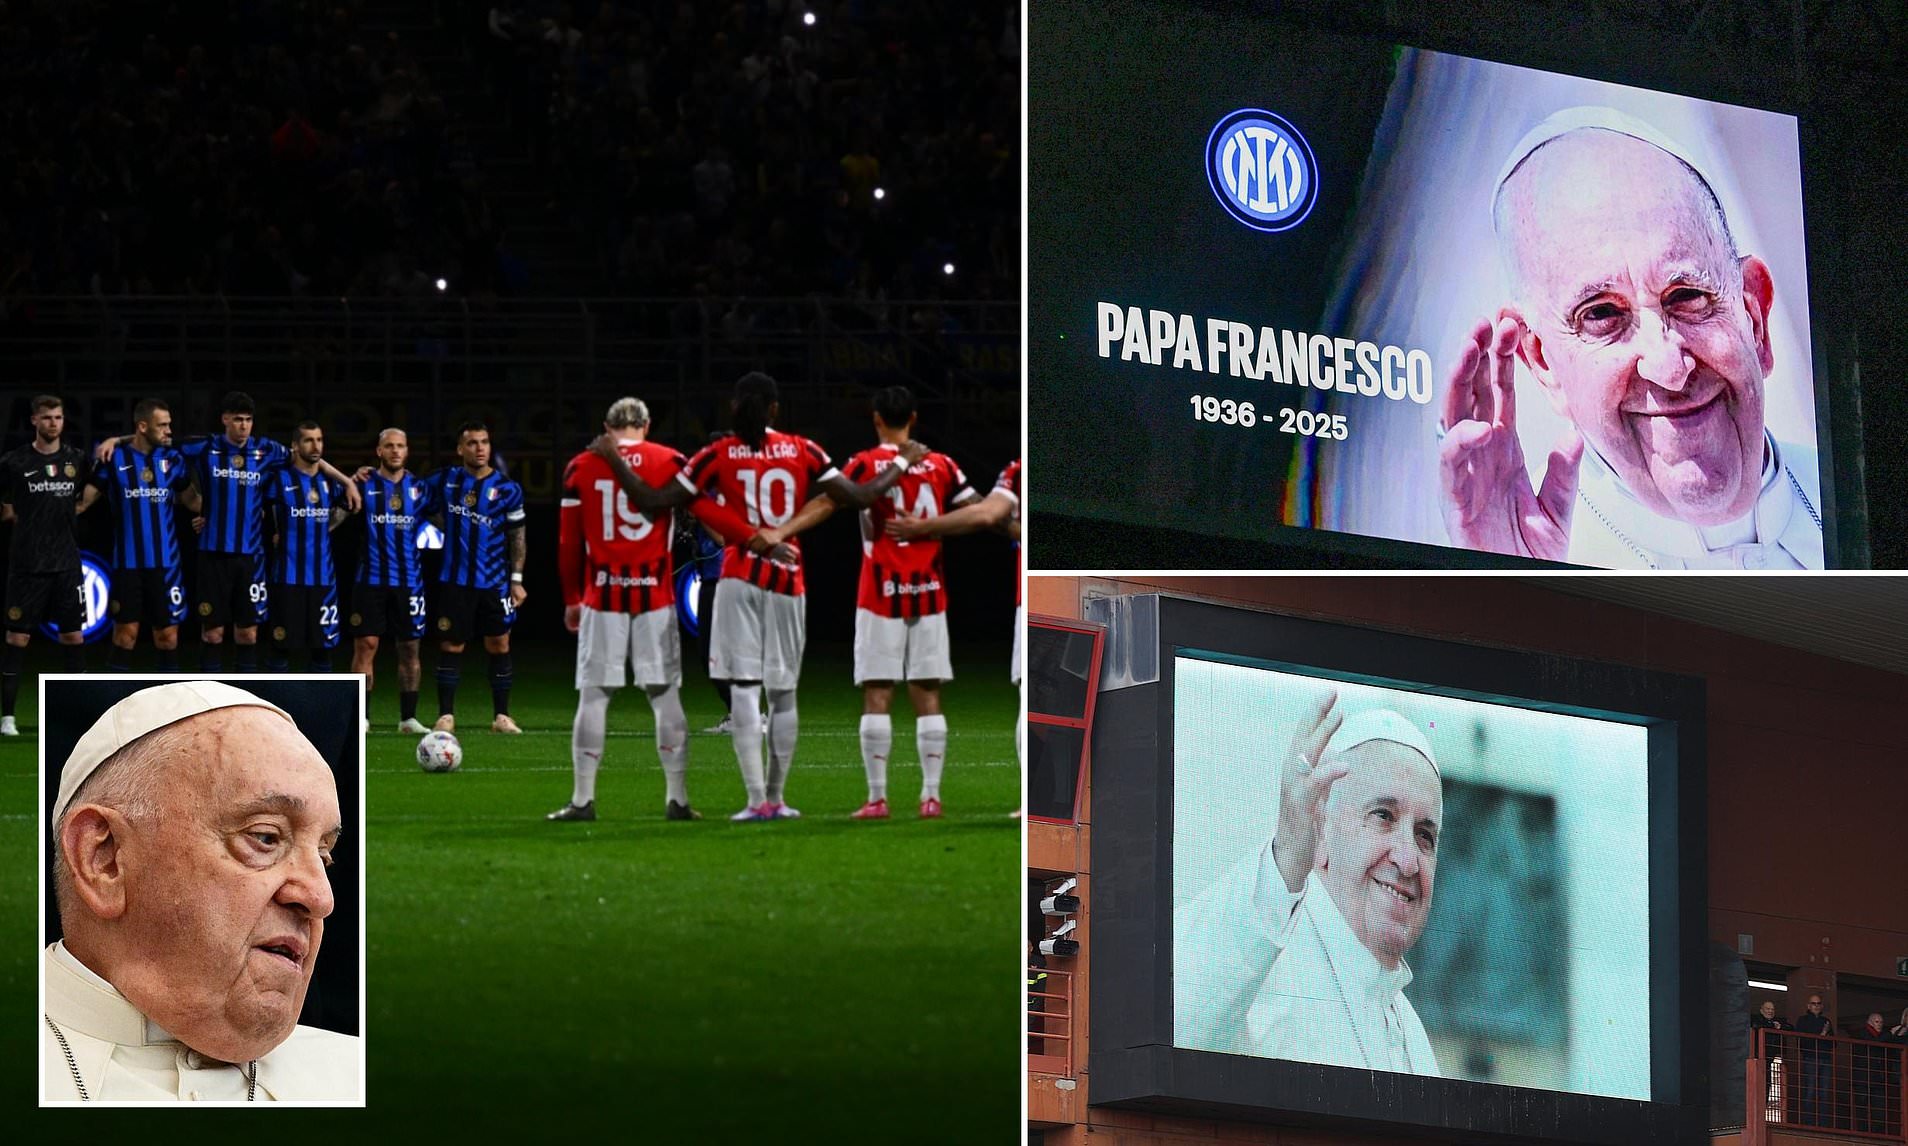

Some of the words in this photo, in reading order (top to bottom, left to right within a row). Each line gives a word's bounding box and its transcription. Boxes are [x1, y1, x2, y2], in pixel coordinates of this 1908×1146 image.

[1097, 301, 1203, 372] PAPA
[1207, 317, 1433, 405] FRANCESCO
[1190, 394, 1256, 428] 1936
[1279, 407, 1349, 441] 2025
[212, 466, 261, 481] betsson
[28, 480, 75, 493] betsson
[124, 486, 170, 499] betsson
[736, 467, 796, 529] 10
[370, 512, 416, 525] betsson
[609, 574, 658, 588] bitpanda
[170, 587, 183, 605] 6
[249, 583, 268, 602] 95
[409, 596, 426, 616] 32
[320, 606, 339, 625] 22
